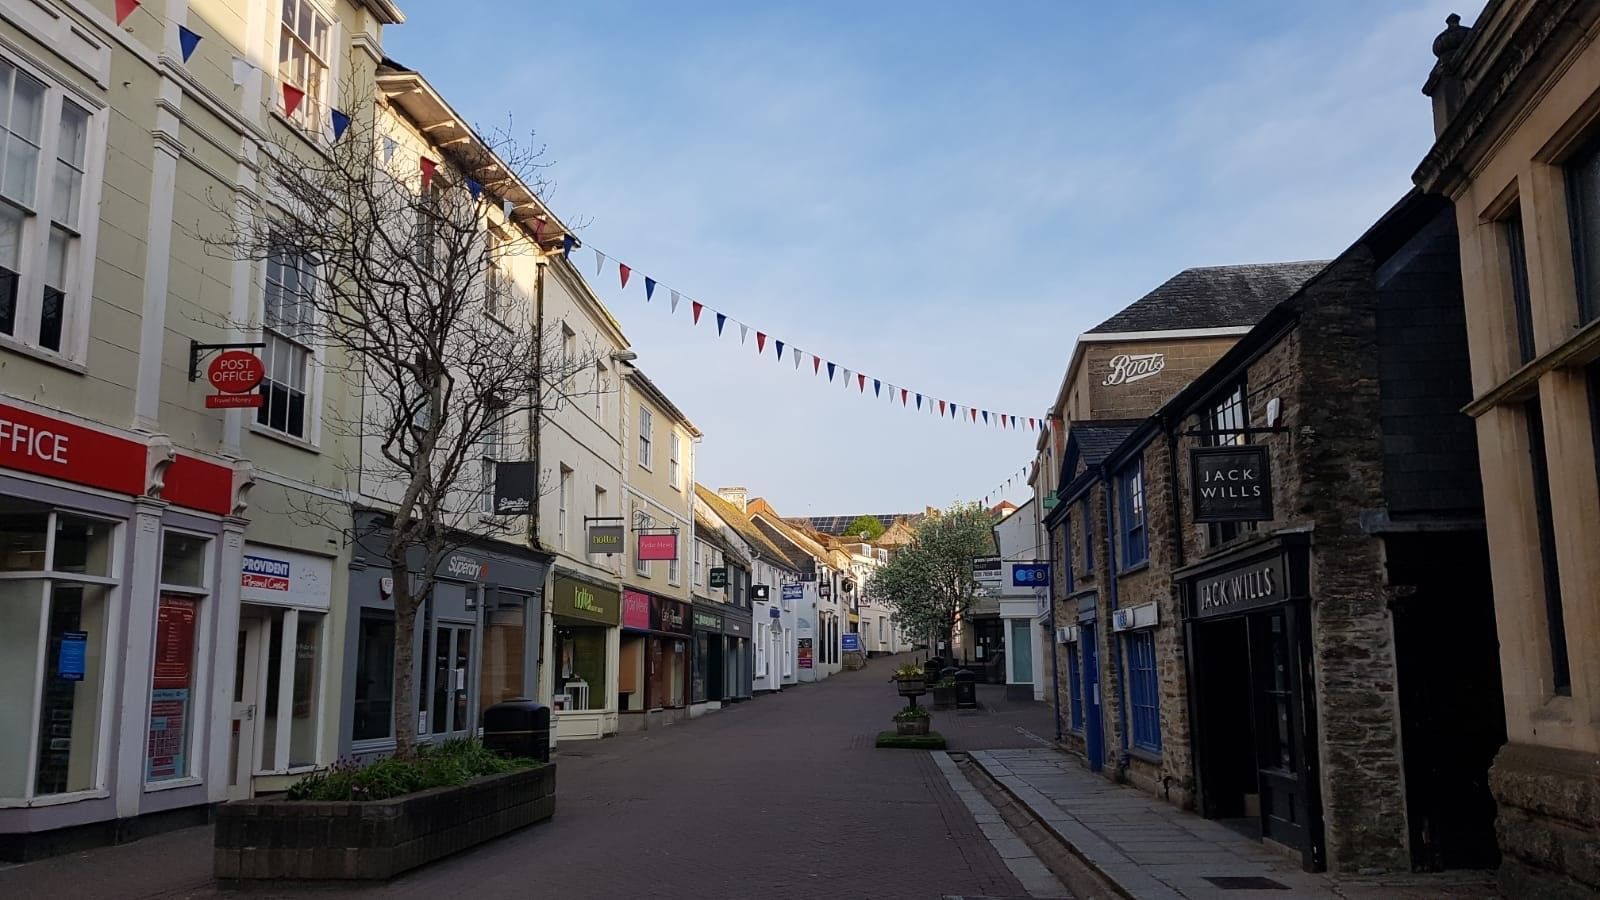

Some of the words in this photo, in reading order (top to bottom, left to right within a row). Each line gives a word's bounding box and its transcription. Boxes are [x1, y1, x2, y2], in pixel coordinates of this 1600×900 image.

[220, 359, 252, 370] POST
[1102, 352, 1165, 386] Boots
[212, 370, 255, 382] OFFICE
[1204, 469, 1253, 482] JACK
[1200, 485, 1261, 498] WILLS
[242, 558, 289, 576] PROVIDENT
[448, 556, 480, 580] Superdry
[1200, 577, 1229, 610] JACK
[1231, 567, 1272, 601] WILLS
